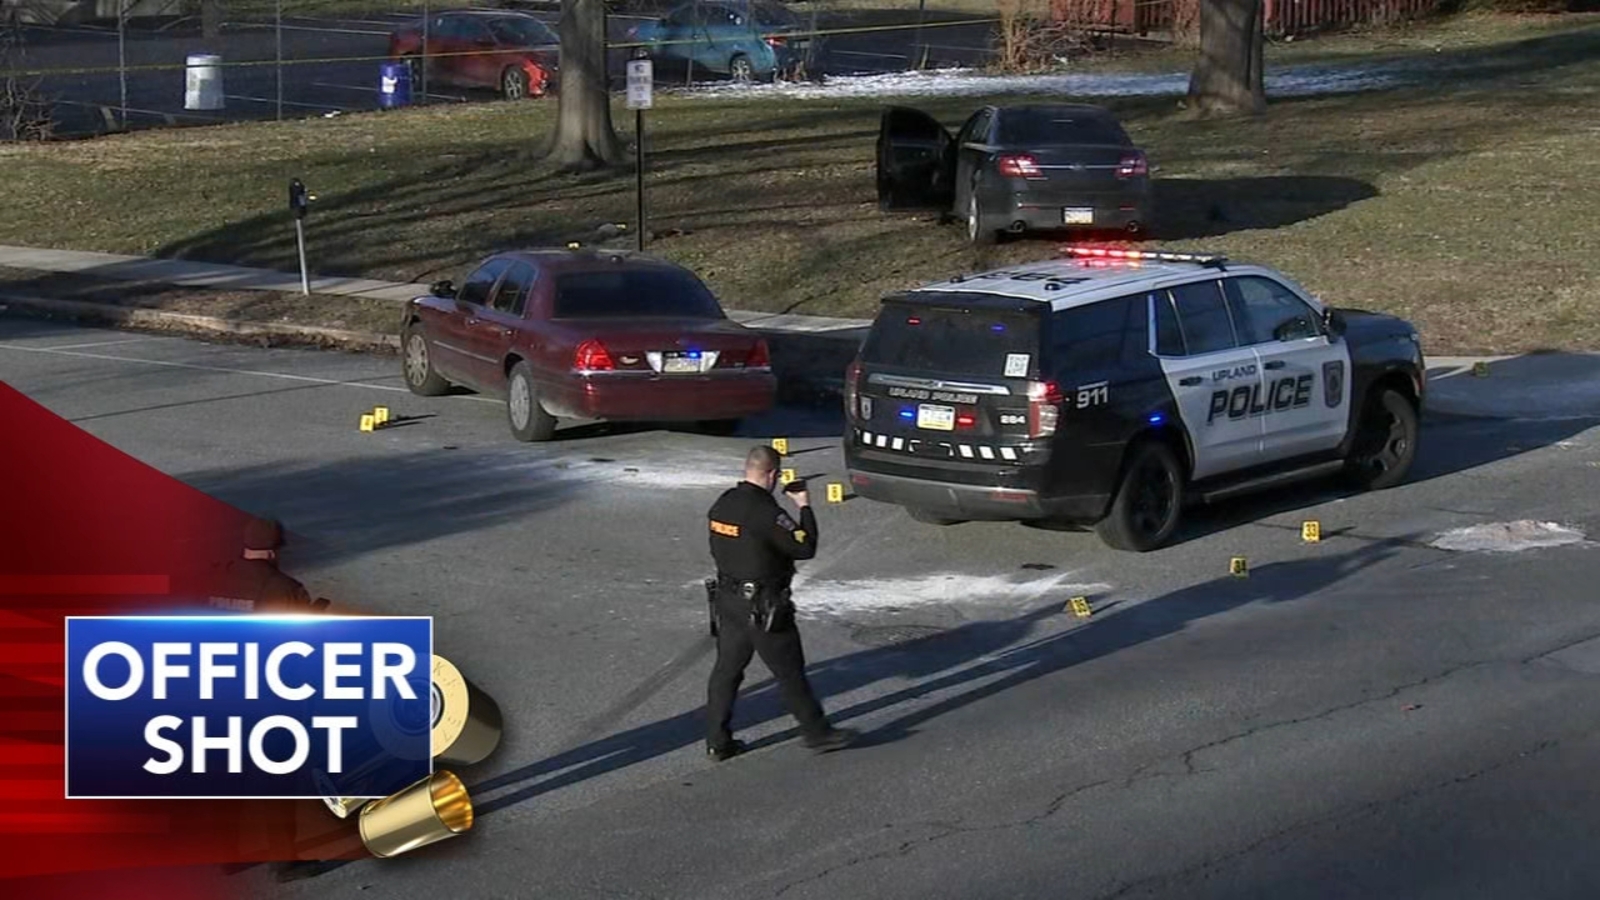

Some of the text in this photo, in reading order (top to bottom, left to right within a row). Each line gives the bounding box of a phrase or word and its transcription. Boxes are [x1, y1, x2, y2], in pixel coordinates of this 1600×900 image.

[1212, 364, 1256, 382] UPLAND
[931, 391, 978, 404] POLICE
[1076, 386, 1108, 409] 911
[1207, 374, 1314, 425] POLICE
[710, 520, 740, 537] POLICE
